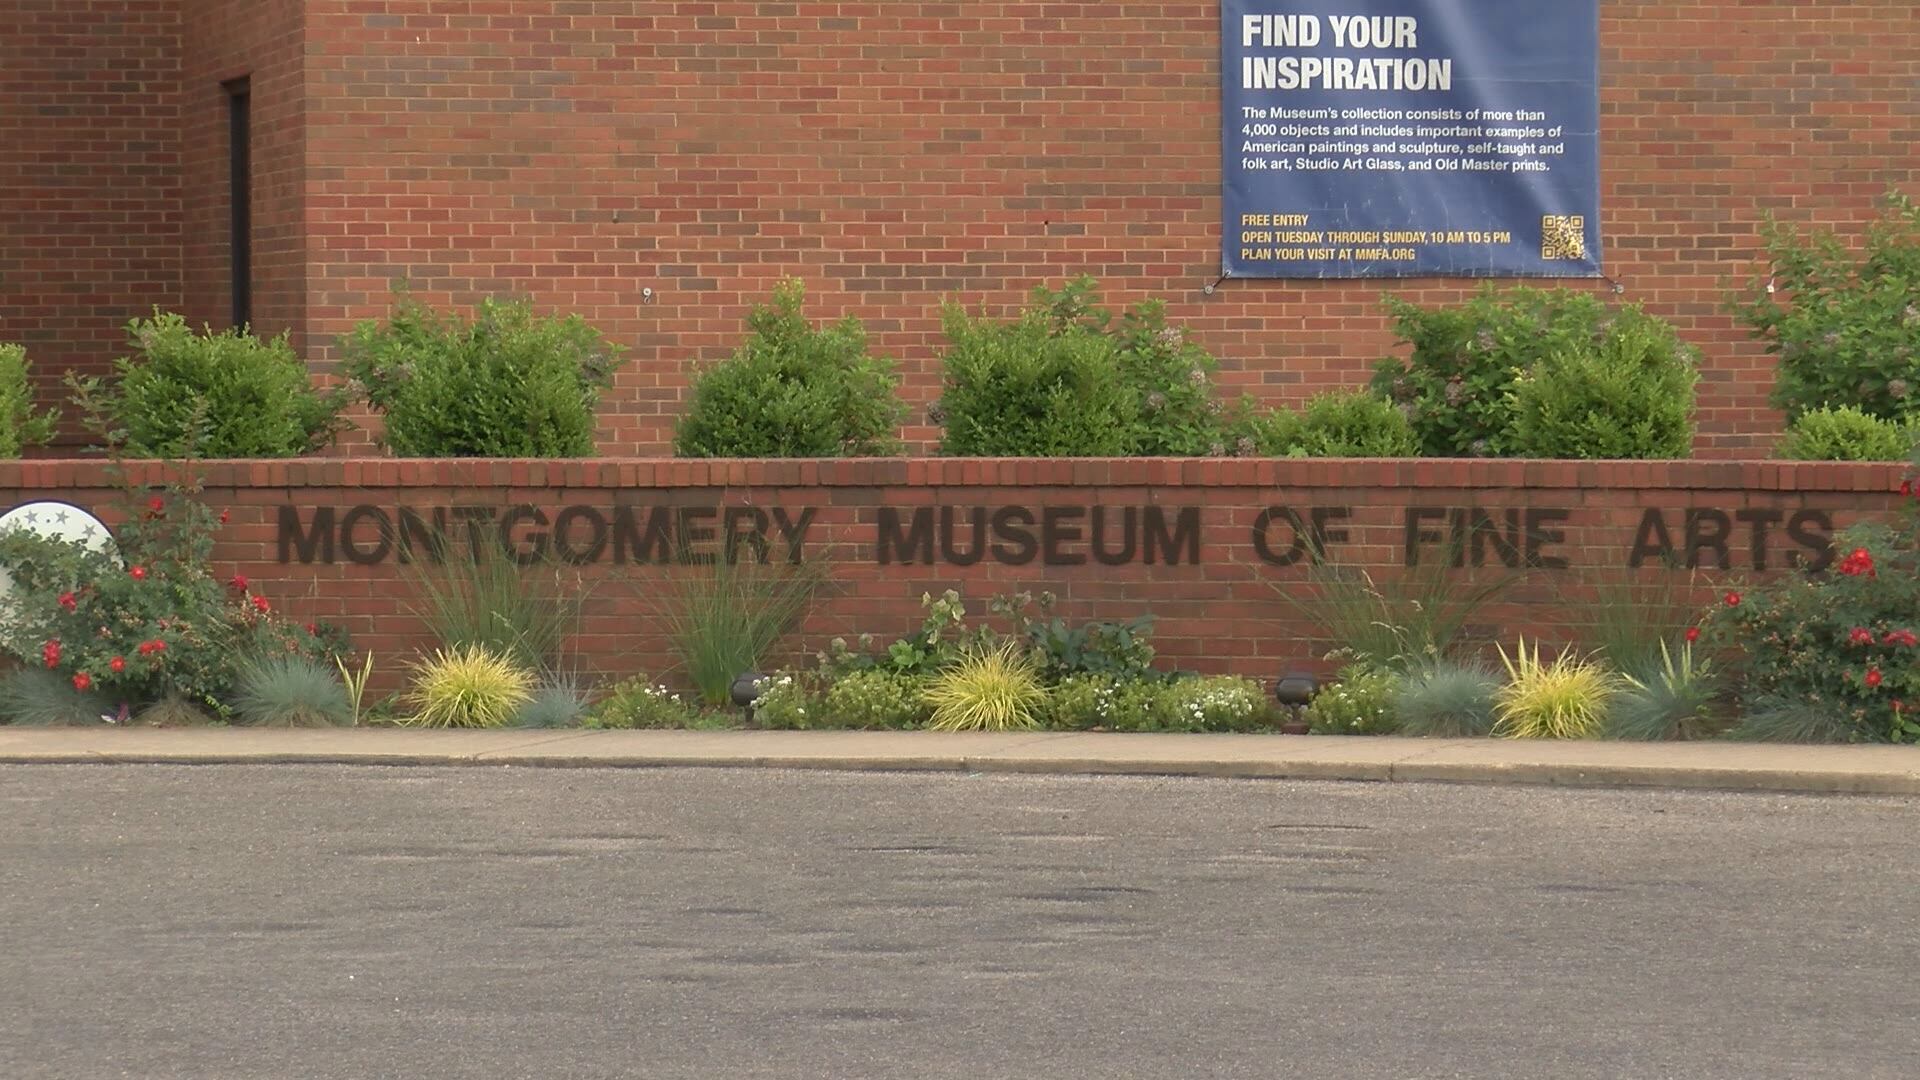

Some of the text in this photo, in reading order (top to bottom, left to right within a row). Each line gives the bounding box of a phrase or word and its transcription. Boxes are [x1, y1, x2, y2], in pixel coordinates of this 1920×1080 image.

[1242, 14, 1417, 49] FIND YOUR
[1242, 57, 1451, 91] INSPIRATION
[1242, 107, 1266, 120] The
[1342, 108, 1402, 120] collection
[1406, 108, 1462, 120] consists
[1465, 108, 1479, 120] of
[1483, 111, 1512, 121] more
[1516, 109, 1544, 121] than
[1242, 124, 1562, 140] 4,000 objects and includes important examples of
[1242, 141, 1563, 156] American paintings and sculpture, self-taught and
[1242, 158, 1550, 173] folk art, Studio Art Glass, and Old Master prints.
[1242, 215, 1308, 226] FREE ENTRY
[1242, 232, 1510, 245] OPEN TUESDAY THROUGH SUNDAY, 10 AM TO 5 PM
[1242, 249, 1415, 260] PLAN YOUR VISIT AT MMFA.ORG
[277, 504, 1834, 572] MONTGOMERY MUSEUM OF FINE ARTS
